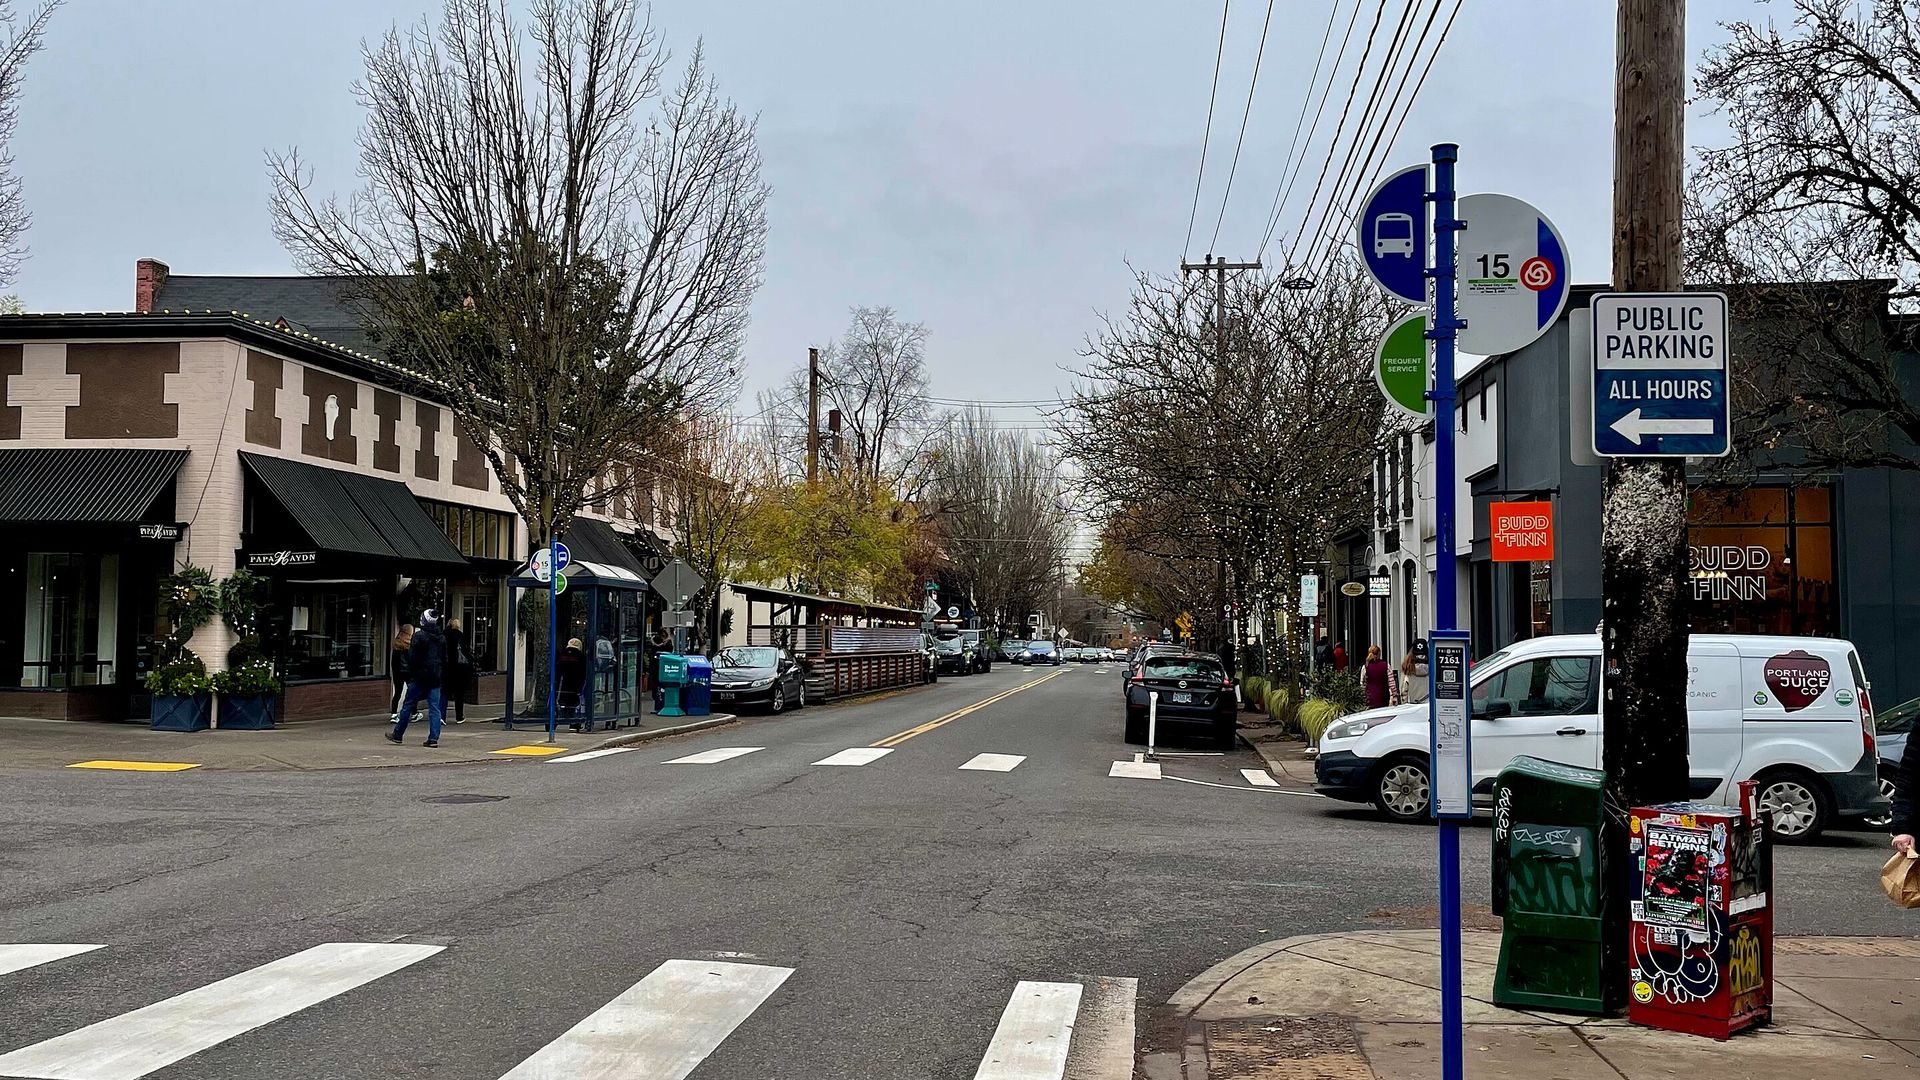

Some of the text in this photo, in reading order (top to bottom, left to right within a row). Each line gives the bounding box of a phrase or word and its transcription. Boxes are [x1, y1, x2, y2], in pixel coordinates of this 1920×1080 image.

[1476, 253, 1510, 279] 15
[1616, 306, 1704, 331] PUBLIC
[1606, 334, 1715, 359] PARKING
[1383, 357, 1422, 365] FREQUENT
[1387, 365, 1418, 373] SERVICE
[1609, 380, 1713, 400] ALL HOURS
[1498, 516, 1549, 531] BUDD
[250, 550, 316, 567] PAPA HAYDN
[1439, 656, 1460, 664] 7161
[1767, 669, 1829, 677] PORTLAND
[1780, 677, 1829, 687] JUICE
[1686, 691, 1717, 699] GANIC
[1649, 832, 1709, 846] BATMAN
[1649, 839, 1708, 853] RETURNS
